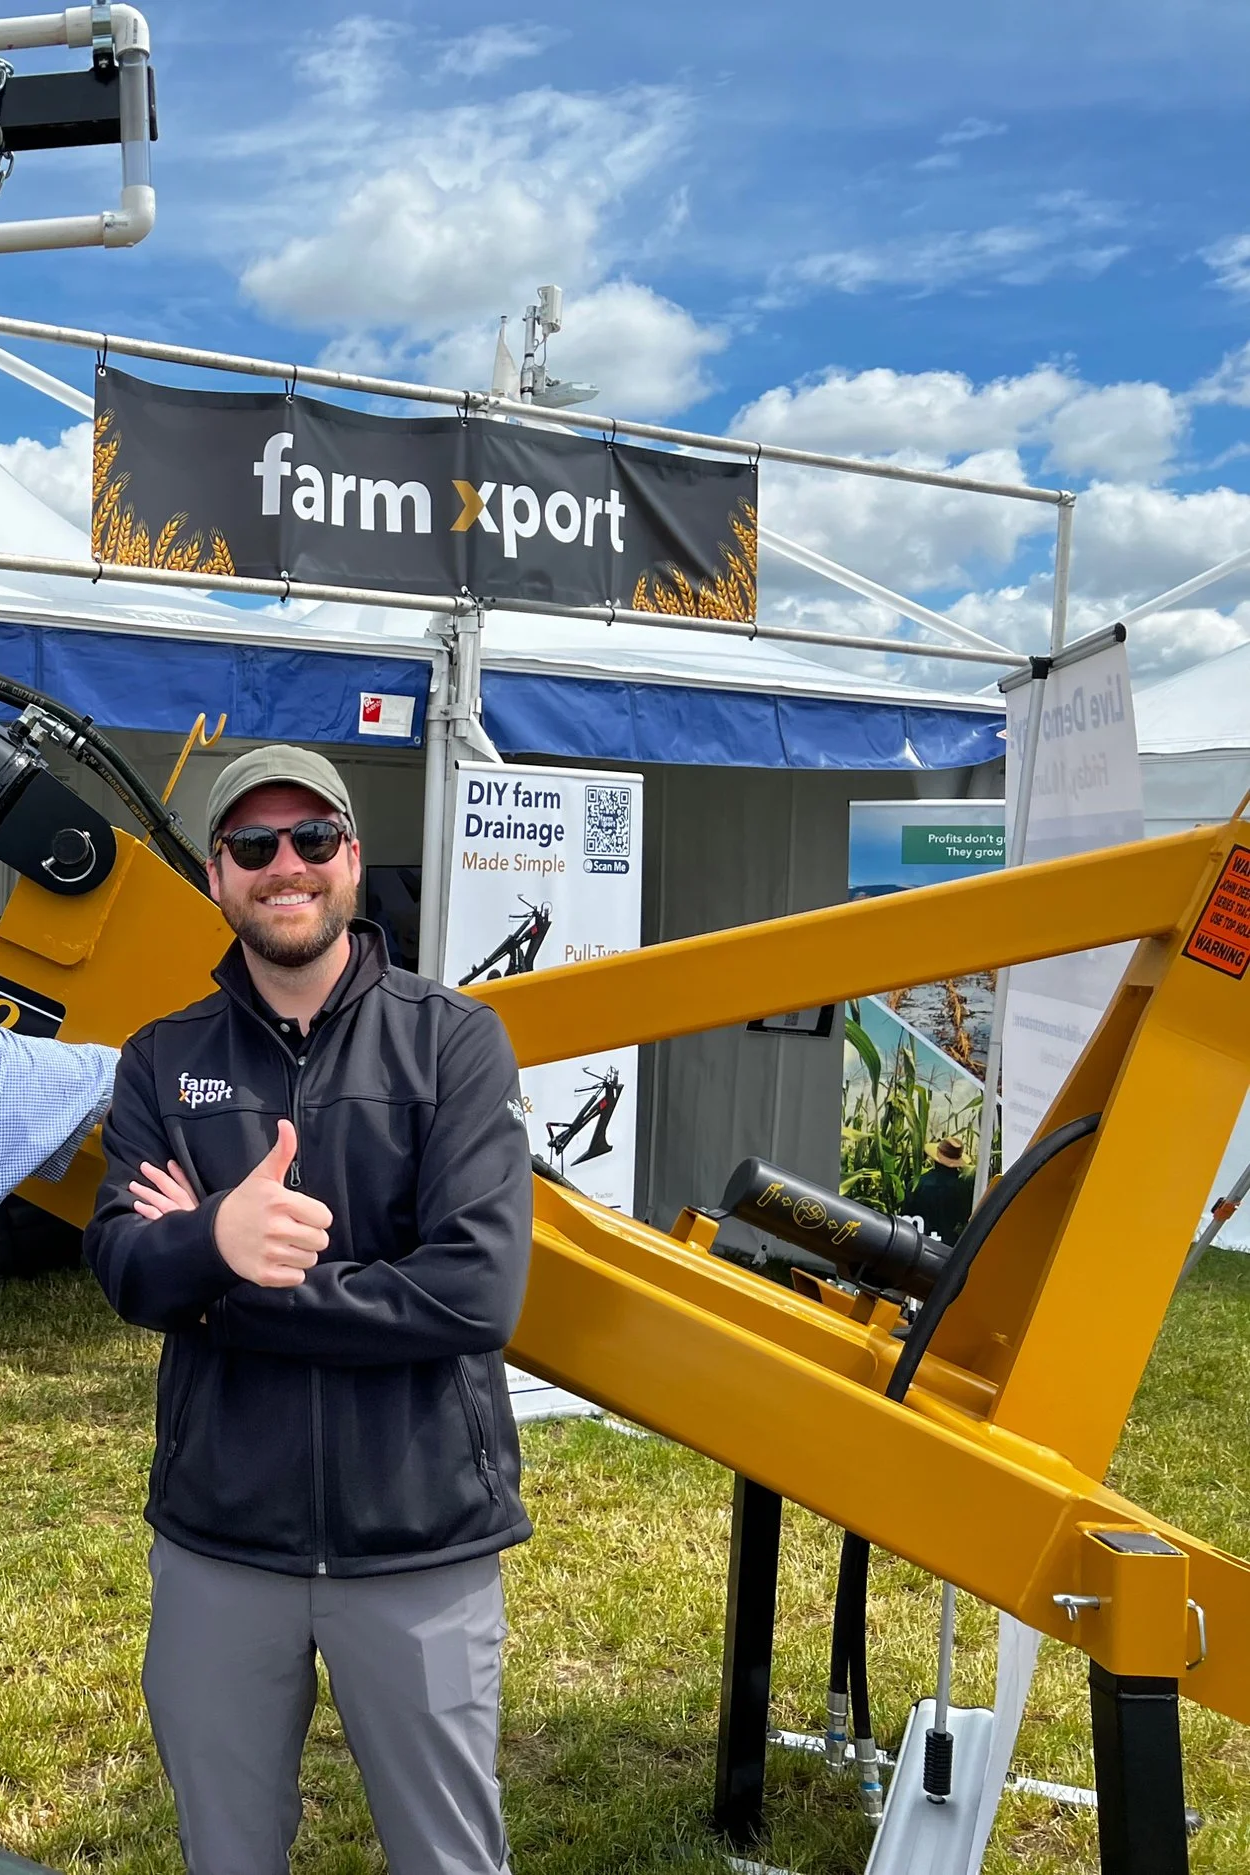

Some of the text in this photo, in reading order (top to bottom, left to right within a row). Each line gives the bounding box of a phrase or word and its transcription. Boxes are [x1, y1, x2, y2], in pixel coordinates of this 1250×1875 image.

[253, 432, 626, 559] farm xport
[468, 780, 561, 809] DIY farm
[465, 813, 565, 848] Drainage
[928, 833, 963, 844] Profits
[964, 833, 994, 844] don’t
[462, 851, 565, 878] Made Simple
[945, 846, 1004, 859] They grow
[593, 860, 627, 873] Scan Me
[565, 943, 627, 962] Pull-T
[1195, 933, 1245, 967] WARNING
[178, 1072, 227, 1092] farm
[178, 1085, 233, 1110] xport
